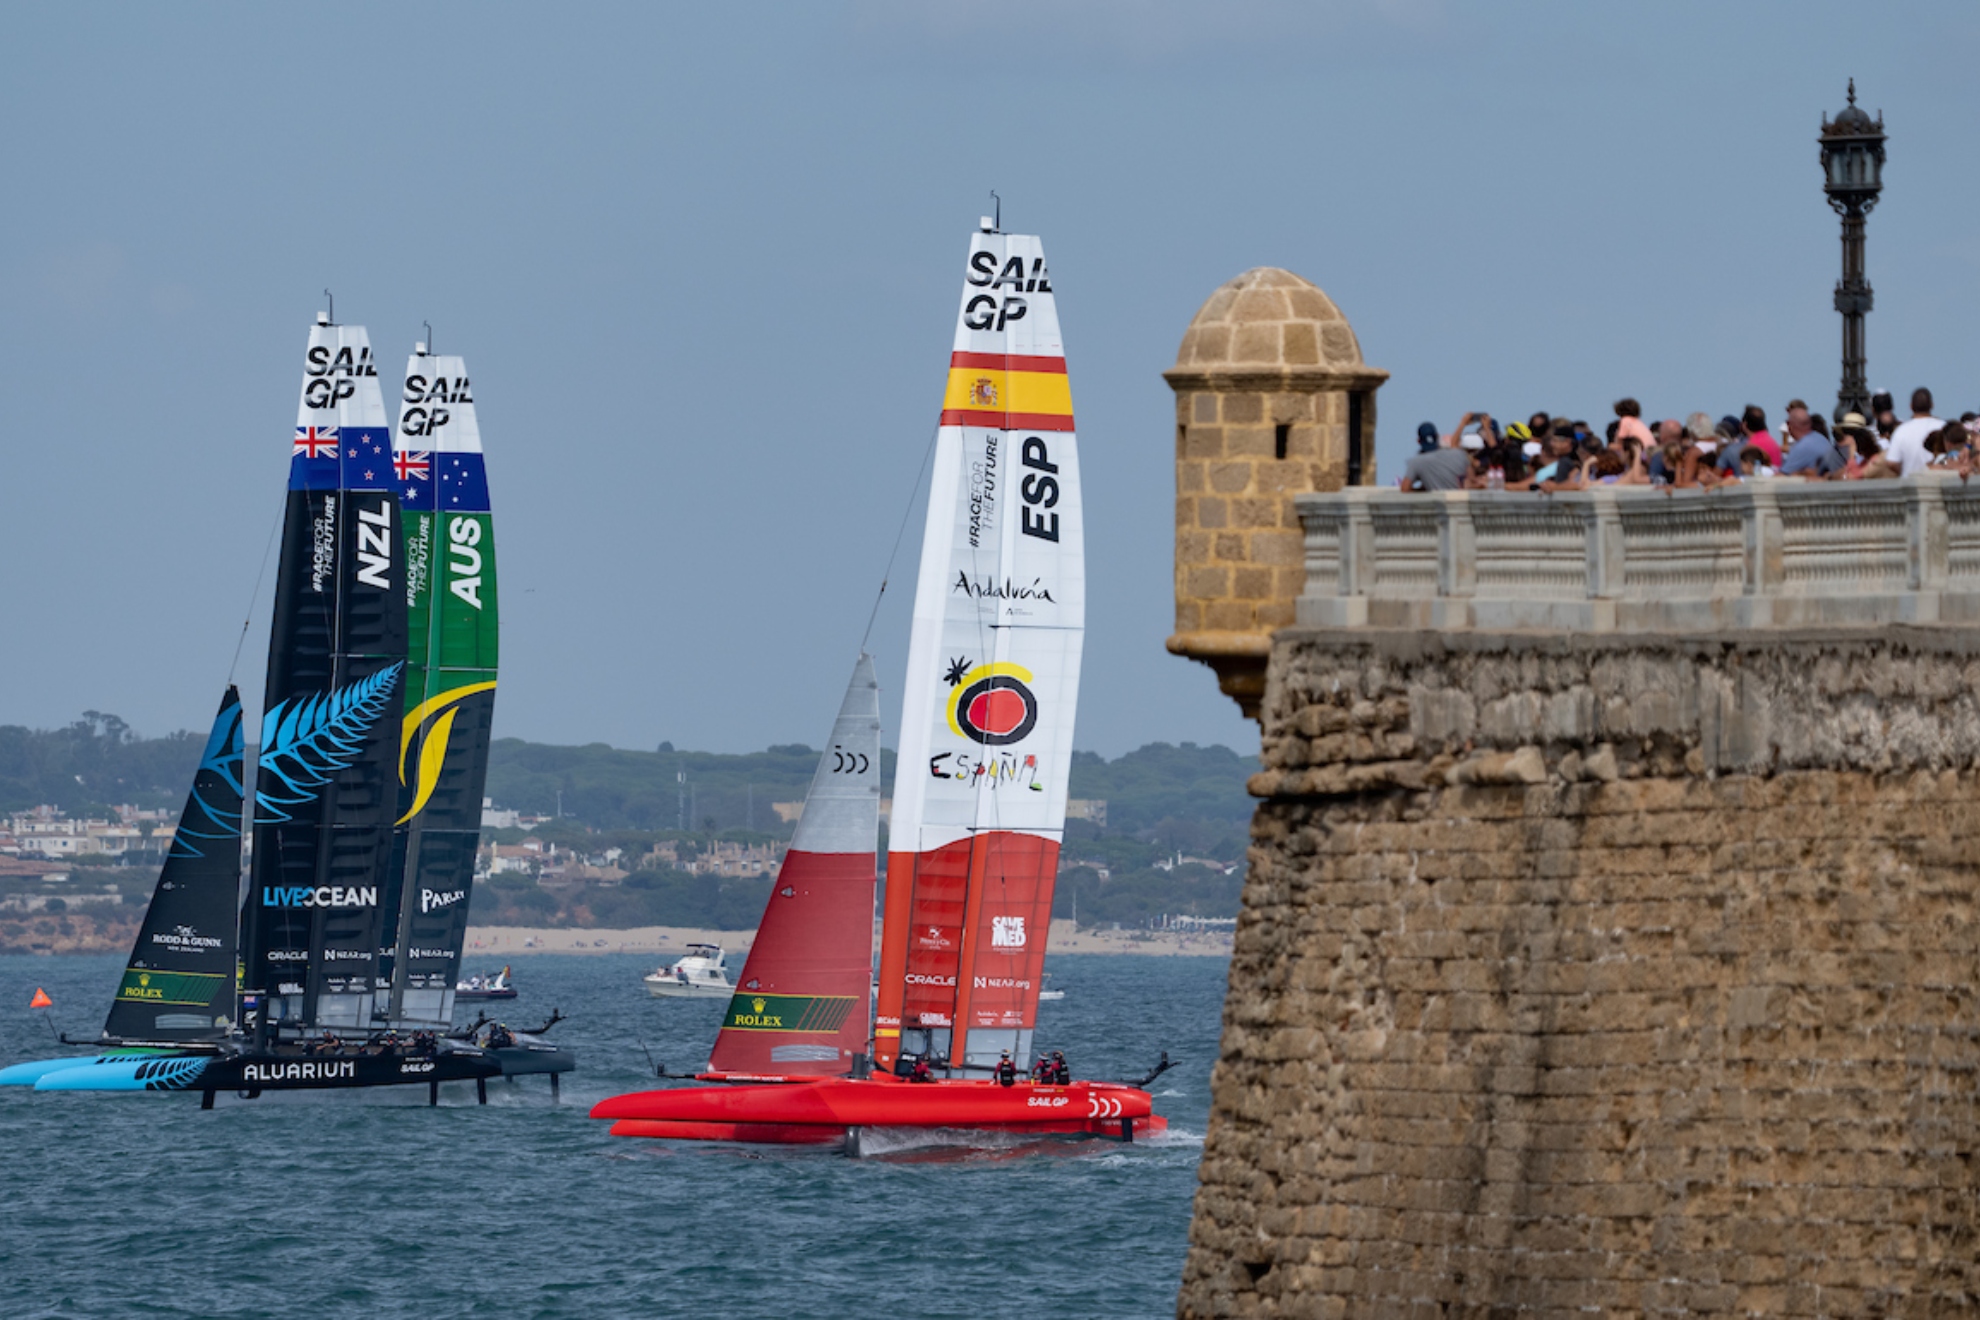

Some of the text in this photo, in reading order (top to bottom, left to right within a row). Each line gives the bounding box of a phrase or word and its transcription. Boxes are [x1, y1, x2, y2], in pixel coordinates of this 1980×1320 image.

[965, 250, 1053, 293] SAIL
[963, 294, 1028, 332] GP
[304, 345, 378, 377] SAIL
[303, 378, 355, 409] GP
[401, 374, 474, 404] SAIL
[400, 407, 450, 436] GP
[1021, 436, 1060, 543] ESP
[357, 500, 391, 590] NZL
[450, 516, 482, 611] AUS
[953, 569, 1057, 604] Andalucía
[991, 928, 1027, 947] MED
[992, 916, 1025, 931] SAVE
[153, 934, 222, 948] RODD & GUNN
[267, 951, 308, 961] ORACLE
[124, 987, 163, 999] ROLEX
[904, 974, 957, 986] ORACLE
[734, 1014, 782, 1027] ROLEX
